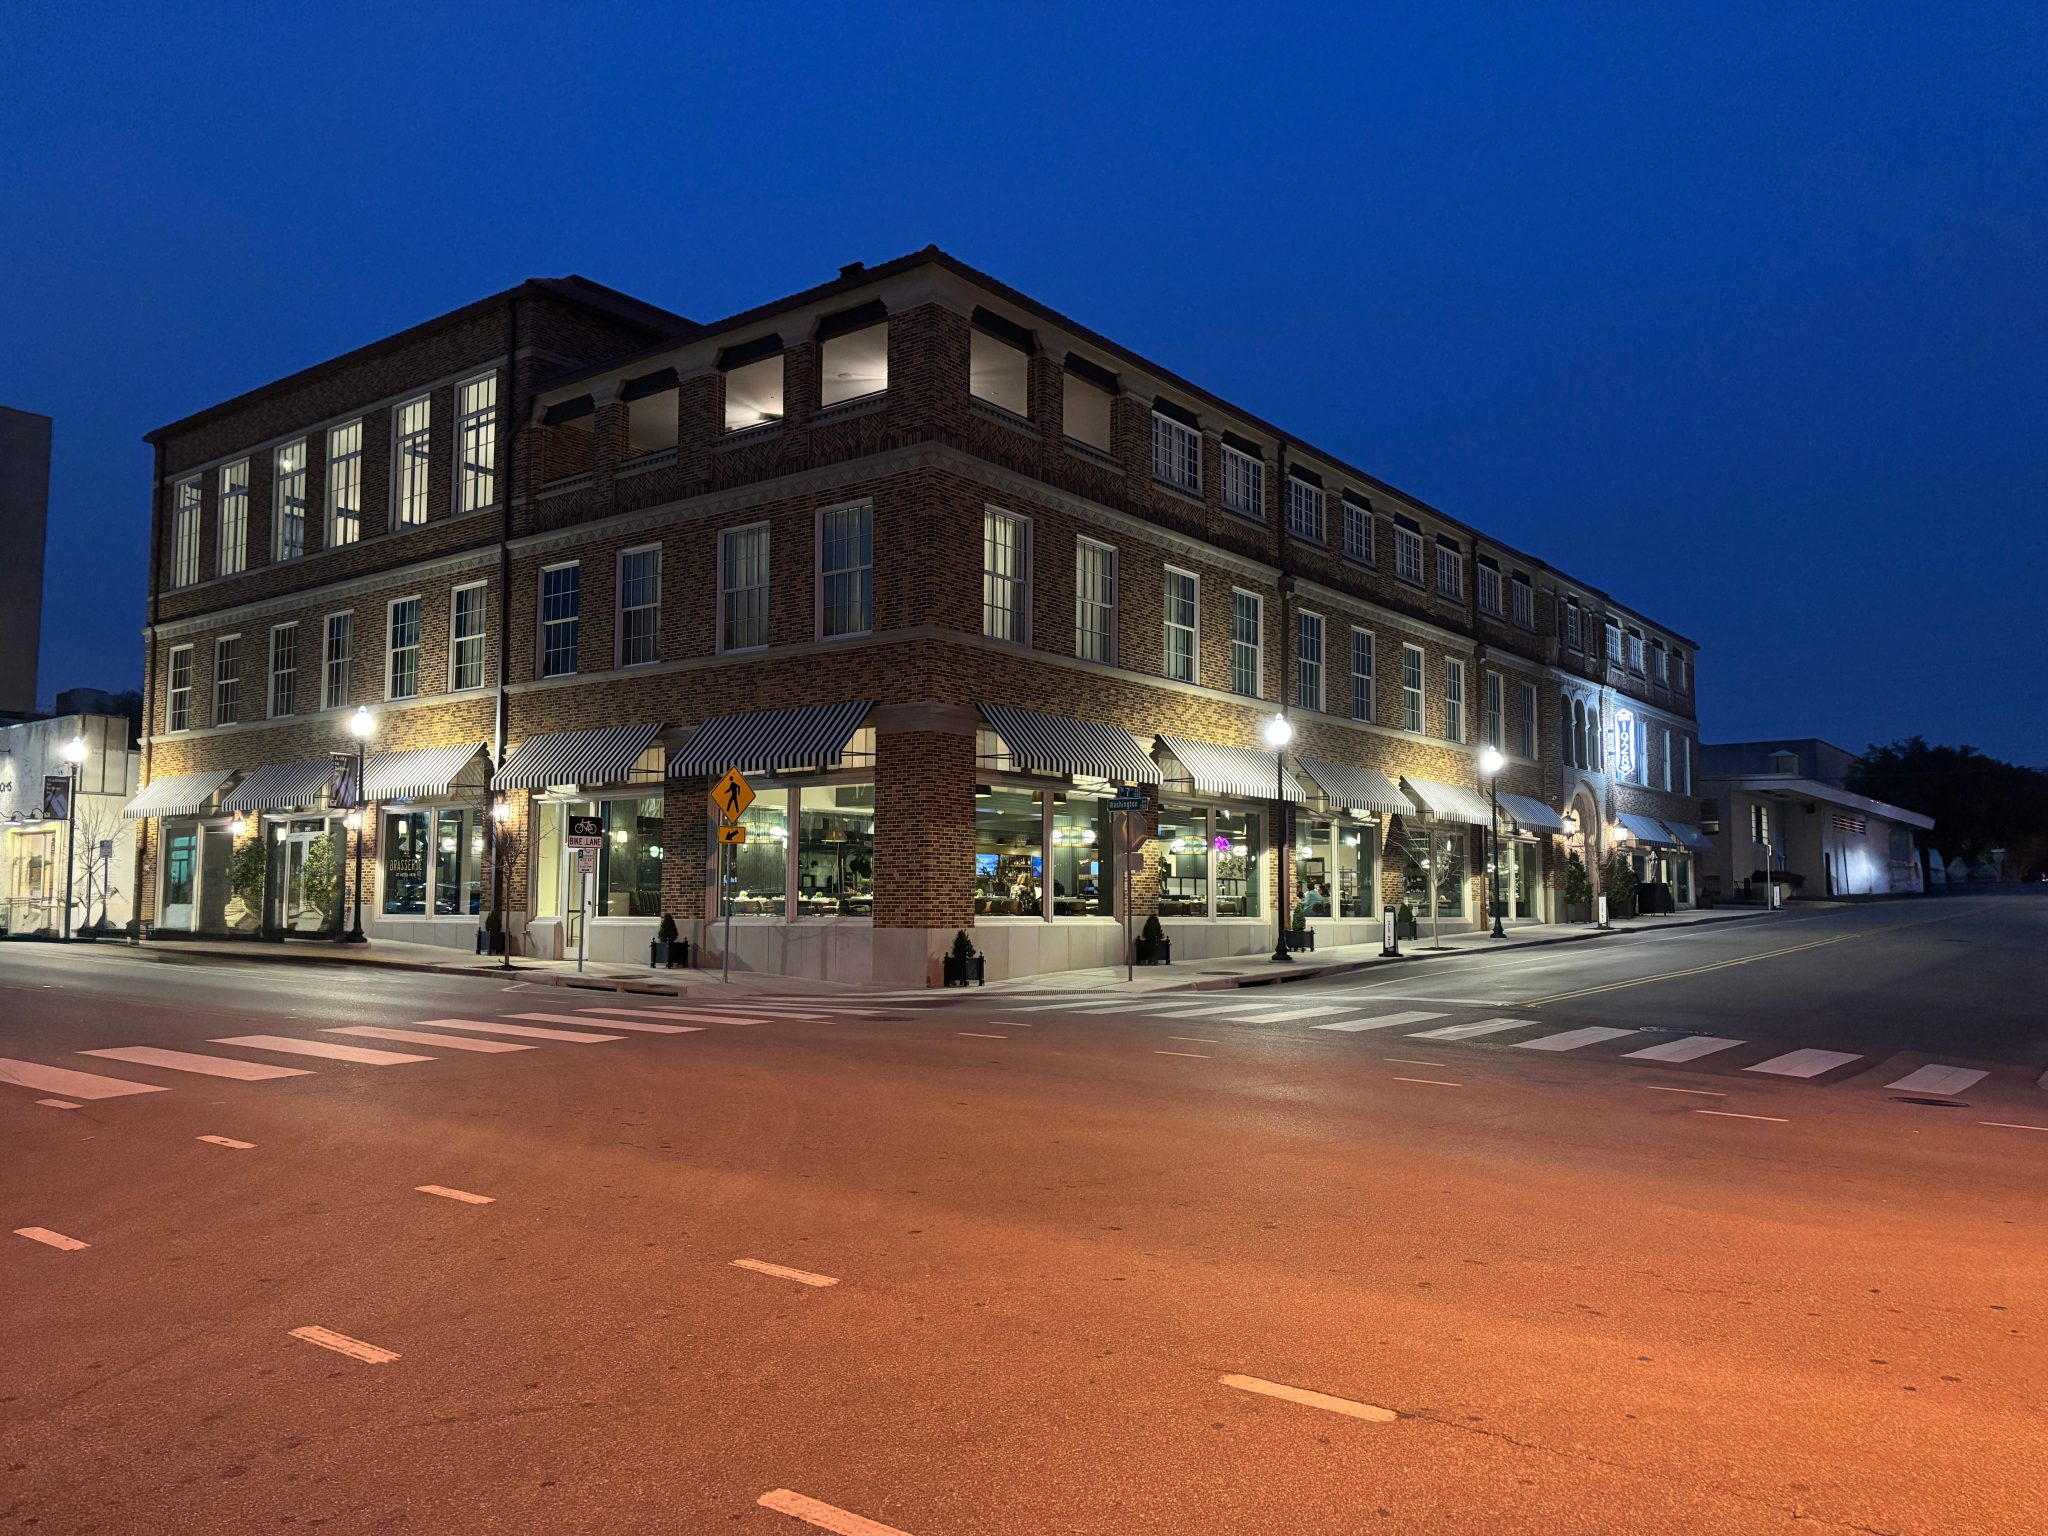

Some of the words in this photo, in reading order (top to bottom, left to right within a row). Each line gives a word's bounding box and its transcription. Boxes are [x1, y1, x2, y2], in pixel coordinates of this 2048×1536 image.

[1620, 721, 1629, 766] 1928
[1109, 800, 1138, 809] Washington
[570, 837, 583, 845] BIKE
[585, 838, 601, 846] LANE
